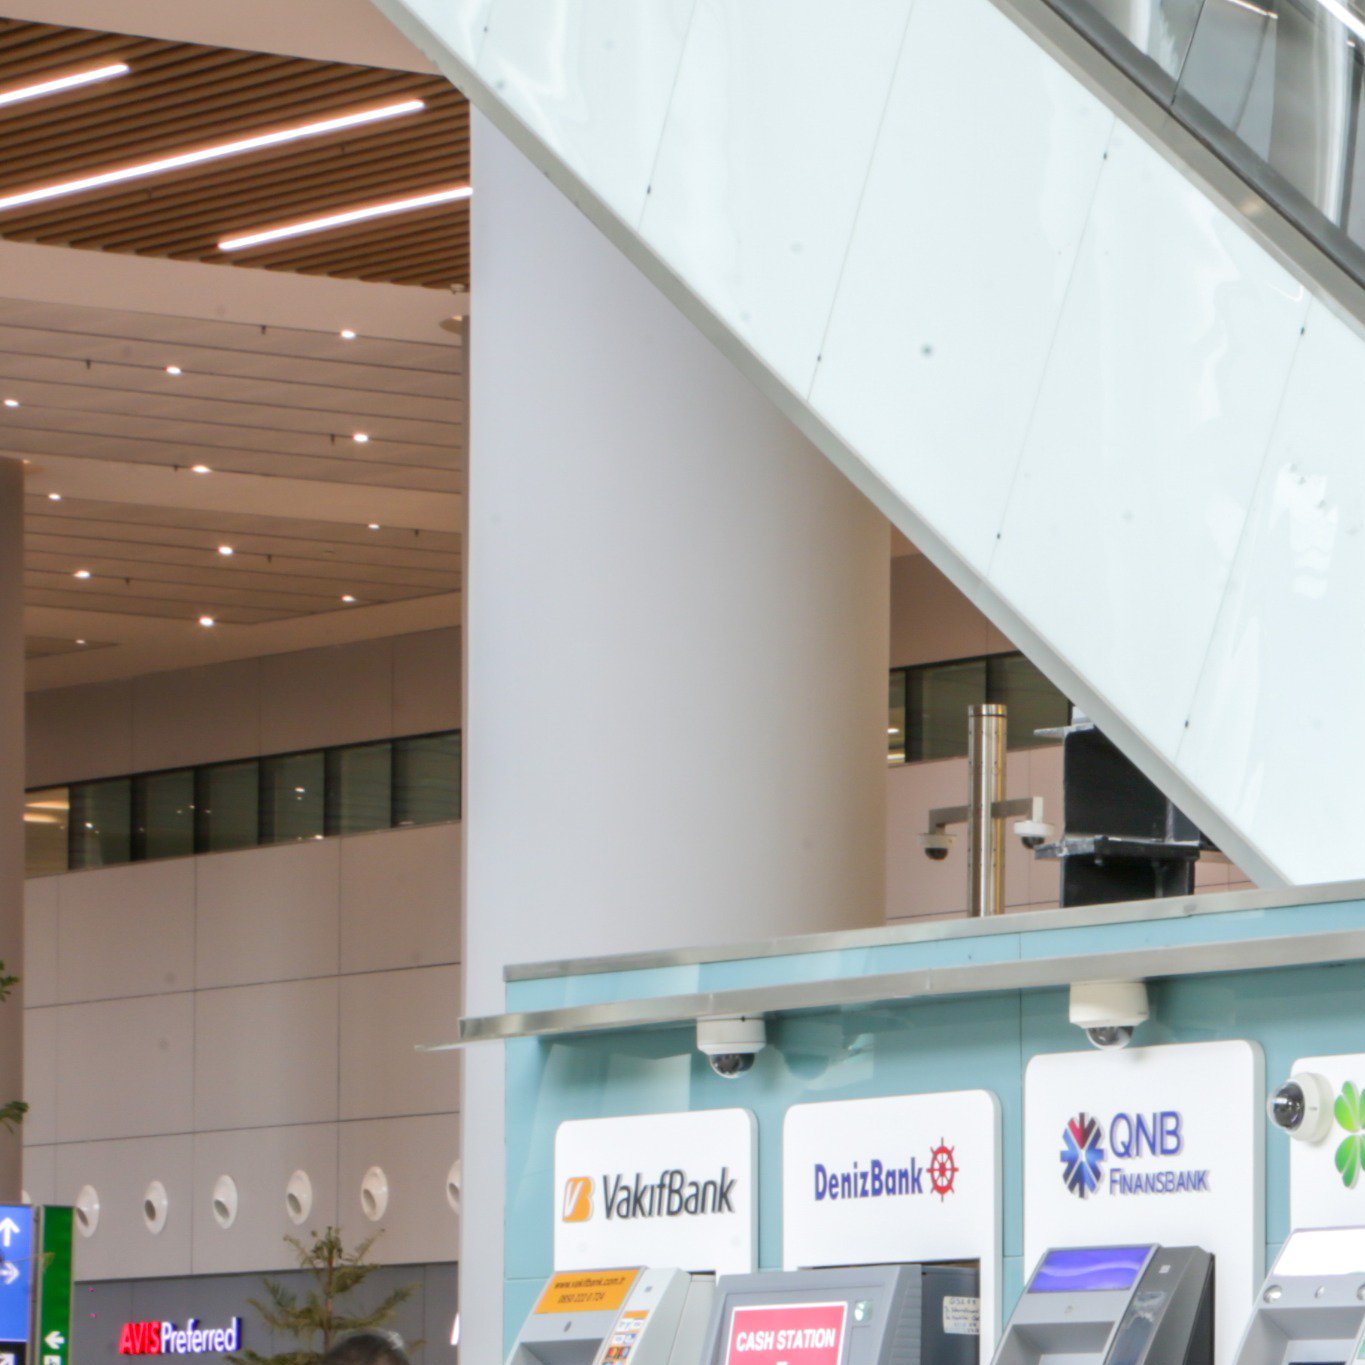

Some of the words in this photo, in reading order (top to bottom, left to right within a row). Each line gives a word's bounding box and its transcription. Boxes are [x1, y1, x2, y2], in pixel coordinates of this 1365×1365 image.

[1109, 1111, 1183, 1158] QNB
[603, 1167, 737, 1220] VakıfBank
[814, 1157, 923, 1201] DenizBank
[736, 1331, 774, 1352] CASH
[776, 1328, 836, 1350] STATION
